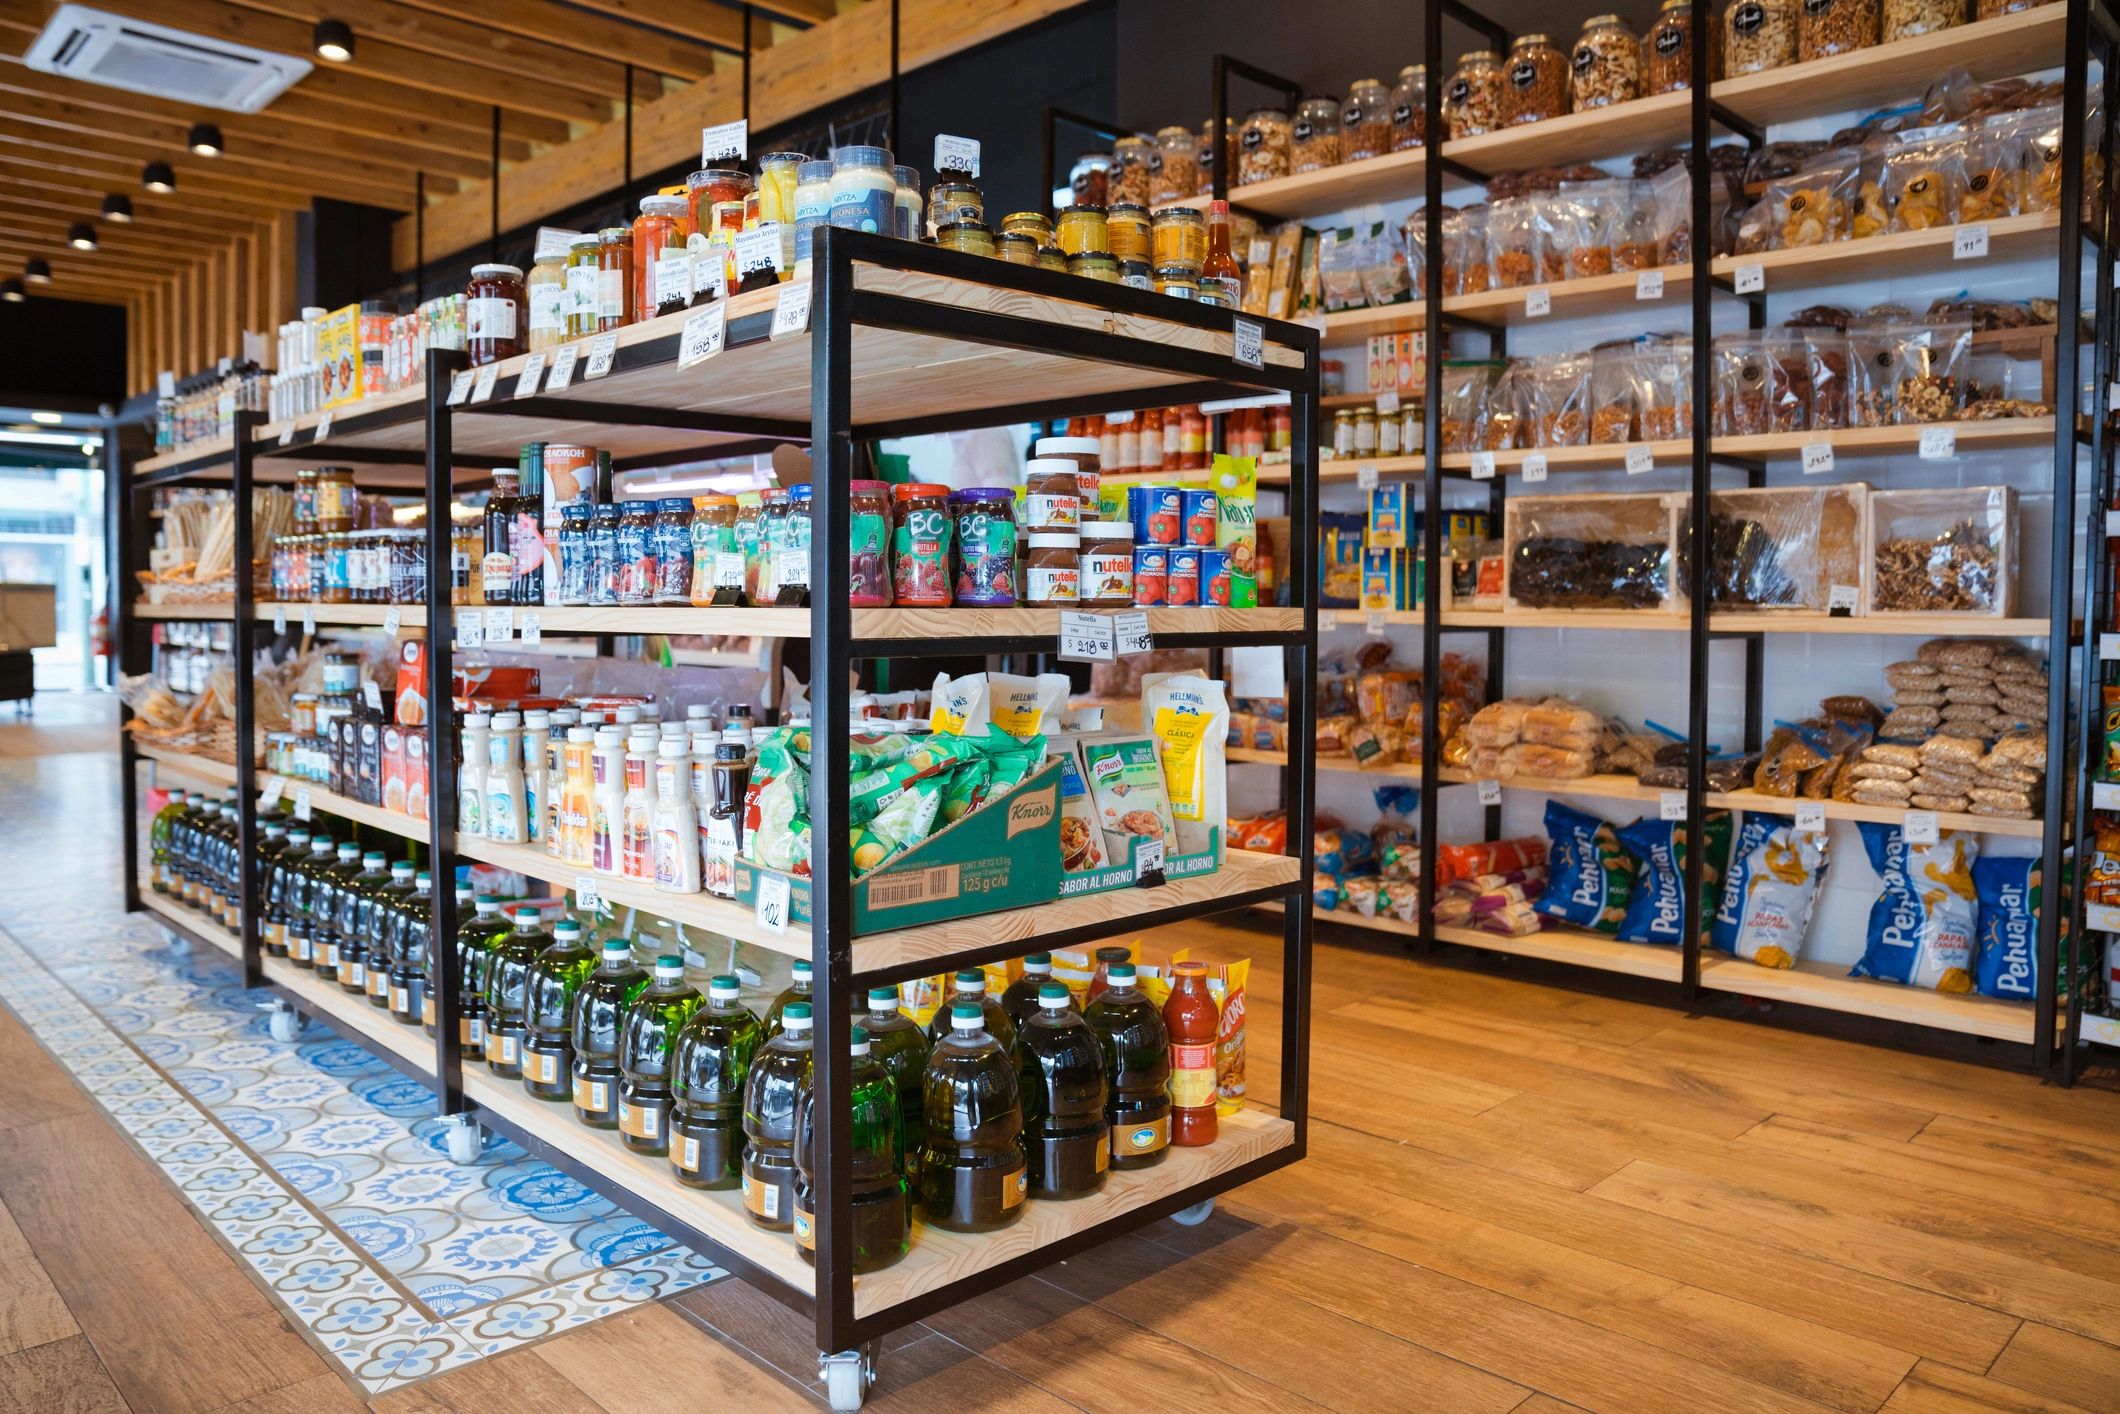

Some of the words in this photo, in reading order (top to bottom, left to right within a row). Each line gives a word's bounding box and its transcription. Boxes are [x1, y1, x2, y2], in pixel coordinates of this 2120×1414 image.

[949, 154, 974, 170] 330
[750, 256, 772, 271] 248
[692, 338, 710, 356] 158
[1046, 498, 1077, 508] nutella
[909, 512, 944, 536] BC
[960, 514, 988, 538] BC
[1048, 572, 1078, 582] nutella
[1078, 614, 1096, 623] Nutella
[1078, 640, 1097, 655] 218
[1096, 758, 1122, 776] Knorr
[1012, 802, 1052, 820] Knorr
[980, 859, 994, 868] NETO
[1175, 862, 1186, 873] AL
[1187, 856, 1214, 870] HORNO
[962, 878, 981, 892] 125
[984, 879, 990, 892] g
[992, 874, 1008, 888] c/u
[1059, 878, 1088, 895] SABOR
[1090, 876, 1100, 888] AL
[1102, 870, 1132, 885] HORNO
[764, 902, 780, 927] 102
